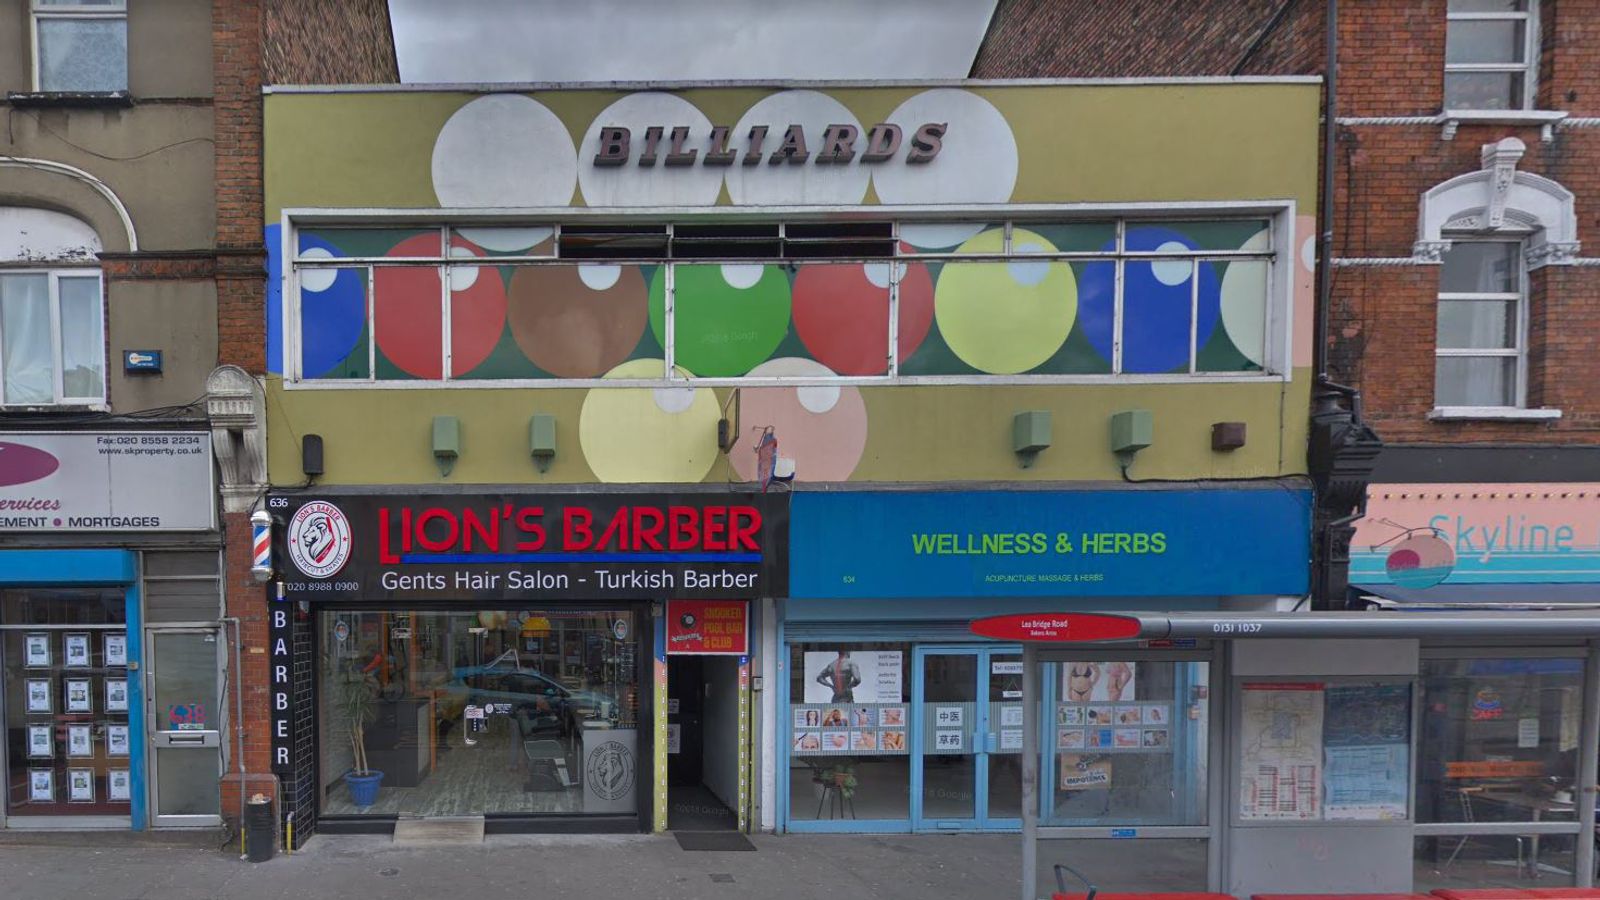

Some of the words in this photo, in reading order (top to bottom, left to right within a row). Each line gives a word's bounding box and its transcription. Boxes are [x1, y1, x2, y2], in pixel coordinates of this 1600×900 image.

[593, 122, 948, 167] BILLIARDS
[141, 436, 169, 445] 8558
[172, 436, 200, 445] 2234
[98, 446, 202, 456] www.skproperty.co.uk
[270, 498, 288, 507] 636
[68, 517, 160, 528] MORTGAGES
[378, 504, 548, 565] LION'S
[563, 505, 763, 553] BARBER
[1430, 514, 1574, 564] Skyline
[912, 533, 1047, 555] WELLNESS
[1055, 533, 1073, 554] &
[1081, 532, 1167, 554] HERBS
[381, 572, 446, 590] Gents
[455, 572, 500, 590] Hair
[508, 571, 568, 589] Salon
[595, 570, 674, 588] Turkish
[684, 570, 758, 588] Barber
[985, 575, 1036, 583] ACUPUNCTURE
[1038, 574, 1072, 582] MASSAGE
[1080, 574, 1104, 582] HERBS
[287, 583, 304, 591] 020
[308, 583, 332, 591] 8988
[335, 583, 358, 591] 0900
[1032, 619, 1051, 630] Bridge
[1051, 619, 1068, 628] Road
[1238, 623, 1262, 632] 1037
[711, 637, 732, 648] CLUB
[274, 610, 289, 764] BARBER
[939, 711, 960, 722] 中医
